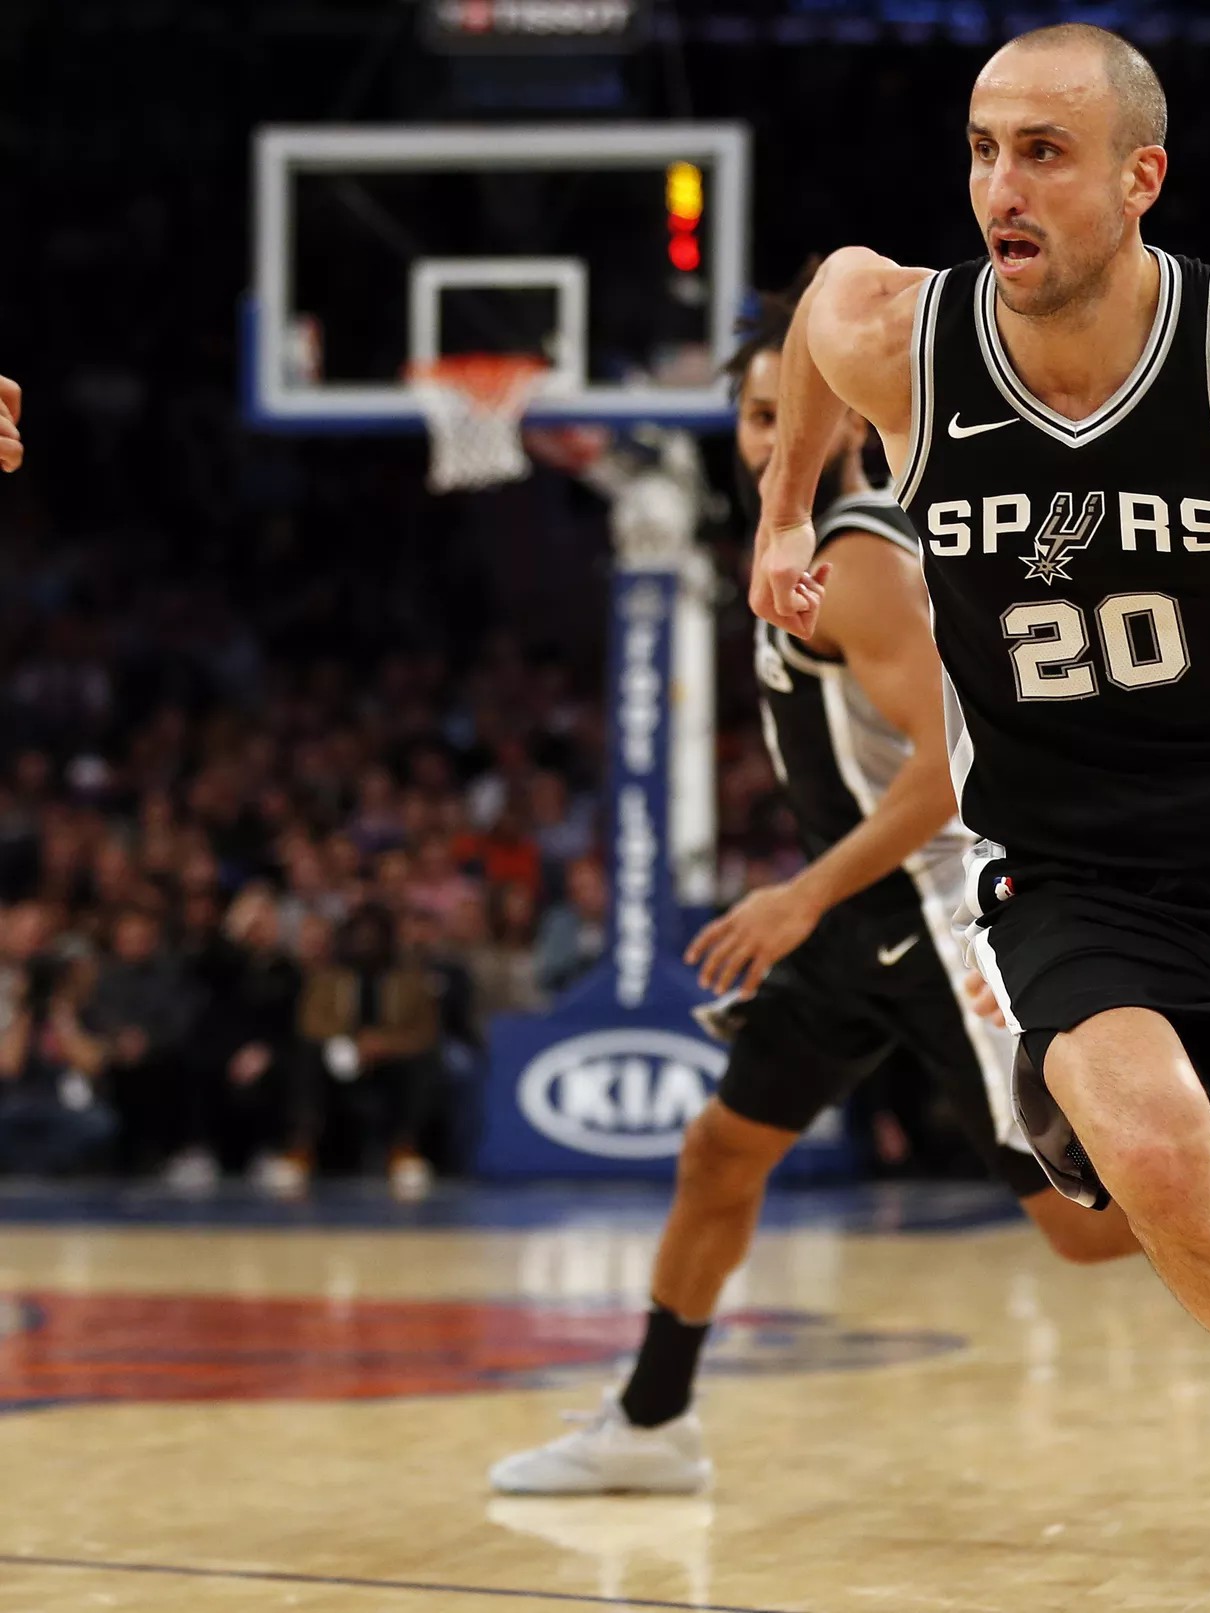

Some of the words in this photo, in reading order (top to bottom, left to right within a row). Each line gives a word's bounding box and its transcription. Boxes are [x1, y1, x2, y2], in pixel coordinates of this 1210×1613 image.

[497, 0, 631, 34] TISSOT
[1000, 591, 1191, 702] 20
[560, 1060, 708, 1128] KIA
